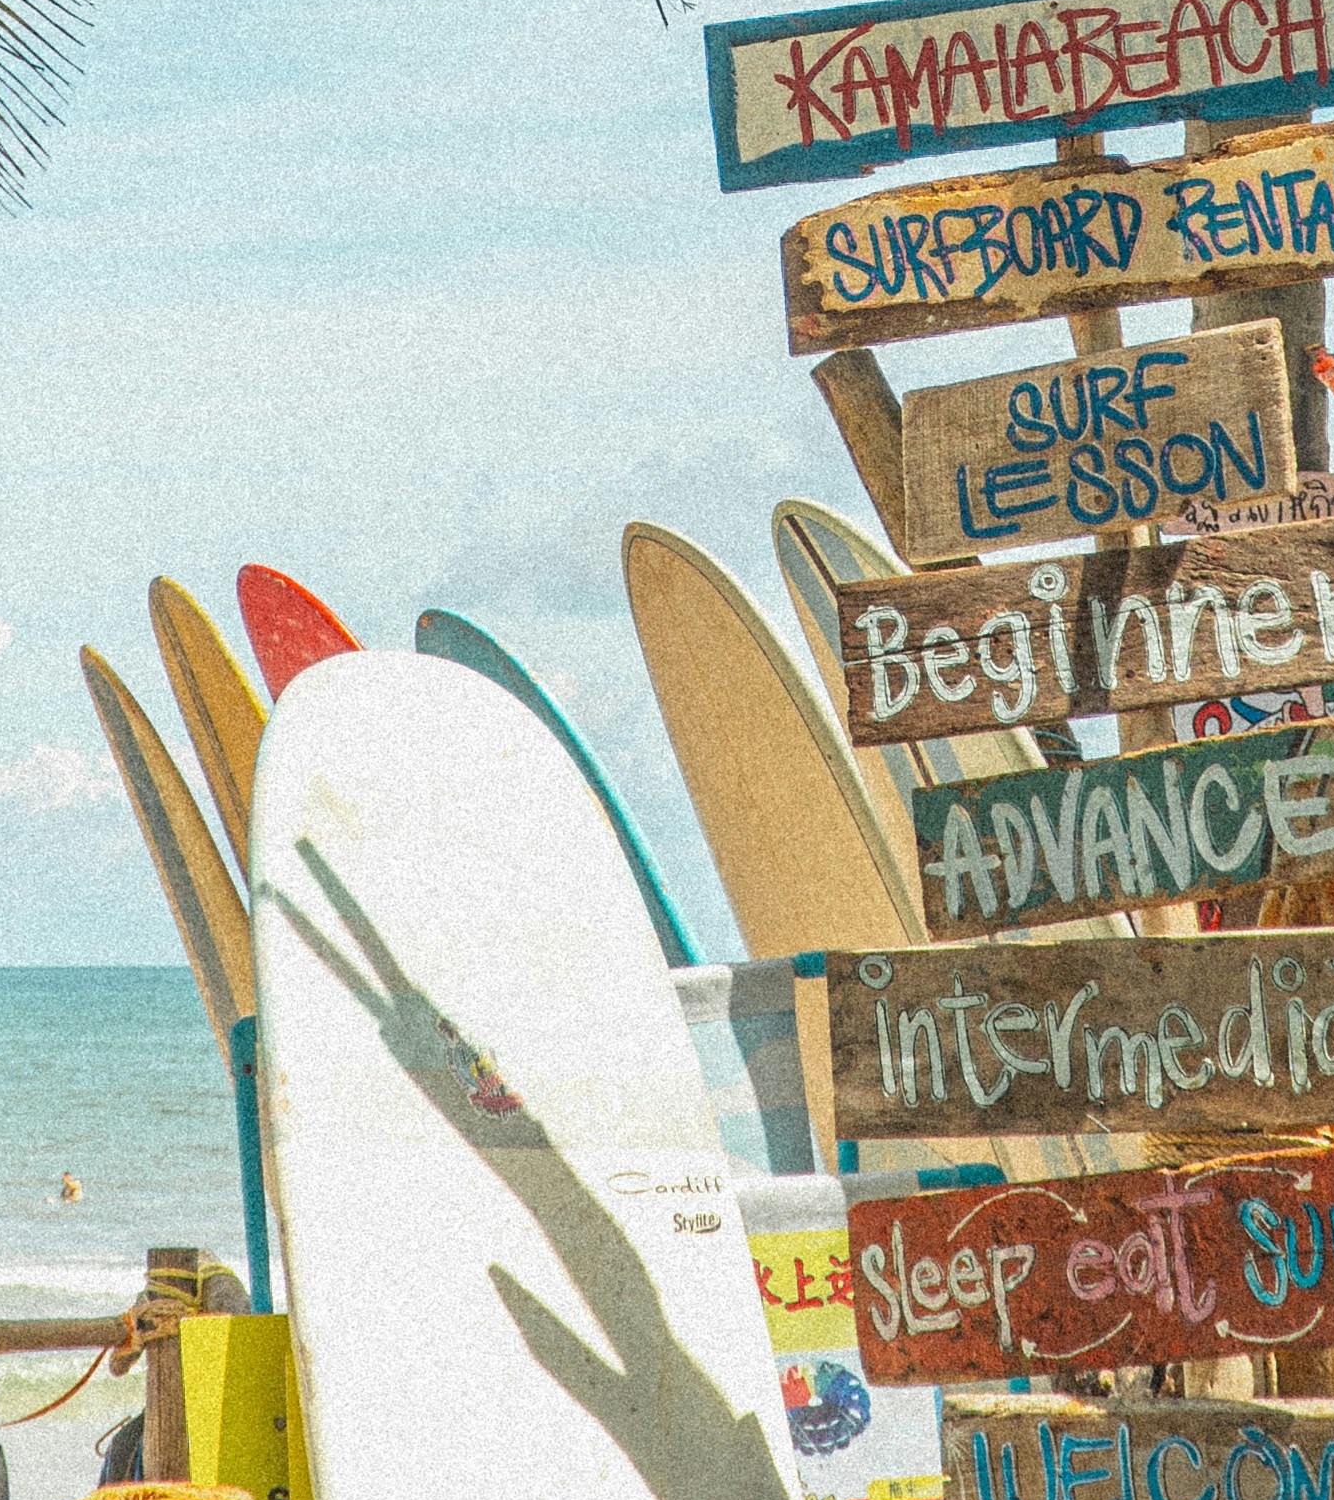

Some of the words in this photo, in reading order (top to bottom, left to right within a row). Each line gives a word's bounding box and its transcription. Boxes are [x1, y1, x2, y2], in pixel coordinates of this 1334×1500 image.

[824, 187, 1146, 305] SURFBOARD
[1006, 351, 1191, 453] SURF
[955, 411, 1268, 541] LESSON
[606, 1171, 724, 1195] Cardiff
[673, 1210, 722, 1235] Stylite
[1065, 1174, 1218, 1325] eat
